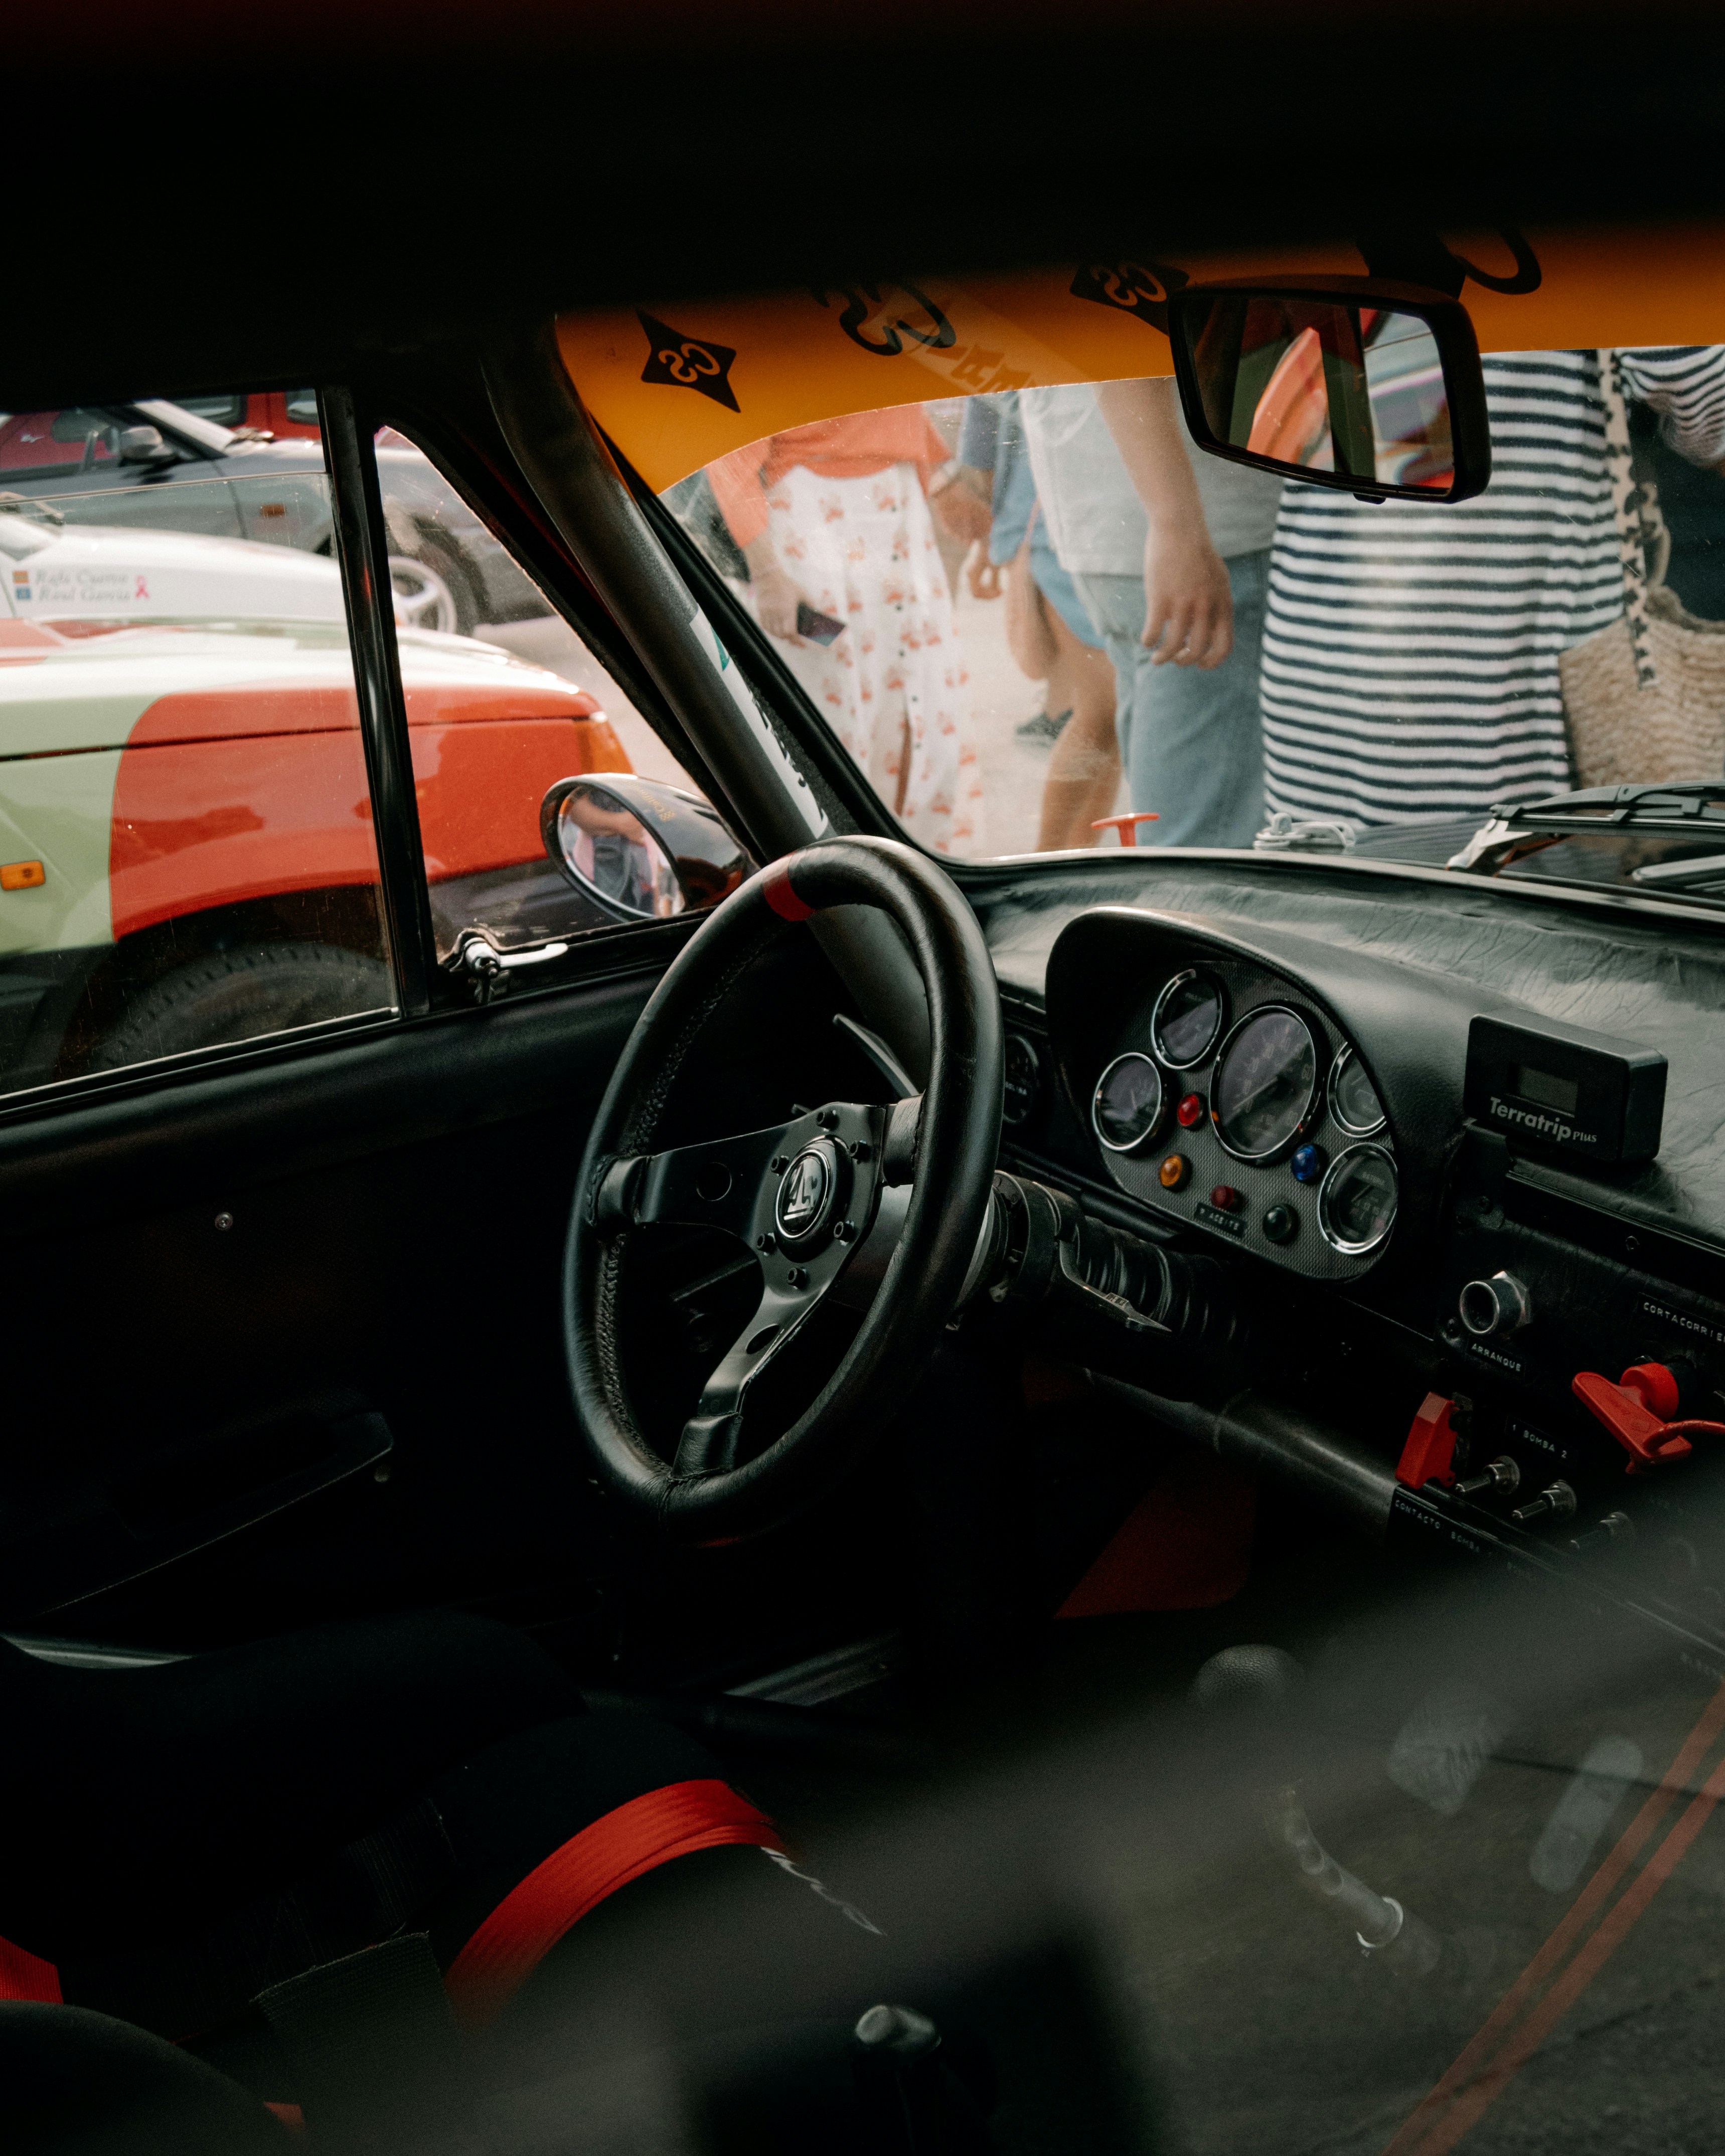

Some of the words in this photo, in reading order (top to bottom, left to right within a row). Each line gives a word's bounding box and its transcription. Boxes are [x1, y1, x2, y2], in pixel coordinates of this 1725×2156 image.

[1490, 1096, 1571, 1142] Terratrip
[1209, 1213, 1239, 1230] ACEITE
[1471, 1342, 1522, 1373] ARRANQUE
[1523, 1429, 1556, 1453] BOMBA
[1561, 1449, 1568, 1459] 2
[1395, 1499, 1441, 1530] CONTACTO
[1451, 1531, 1481, 1553] BOMBA
